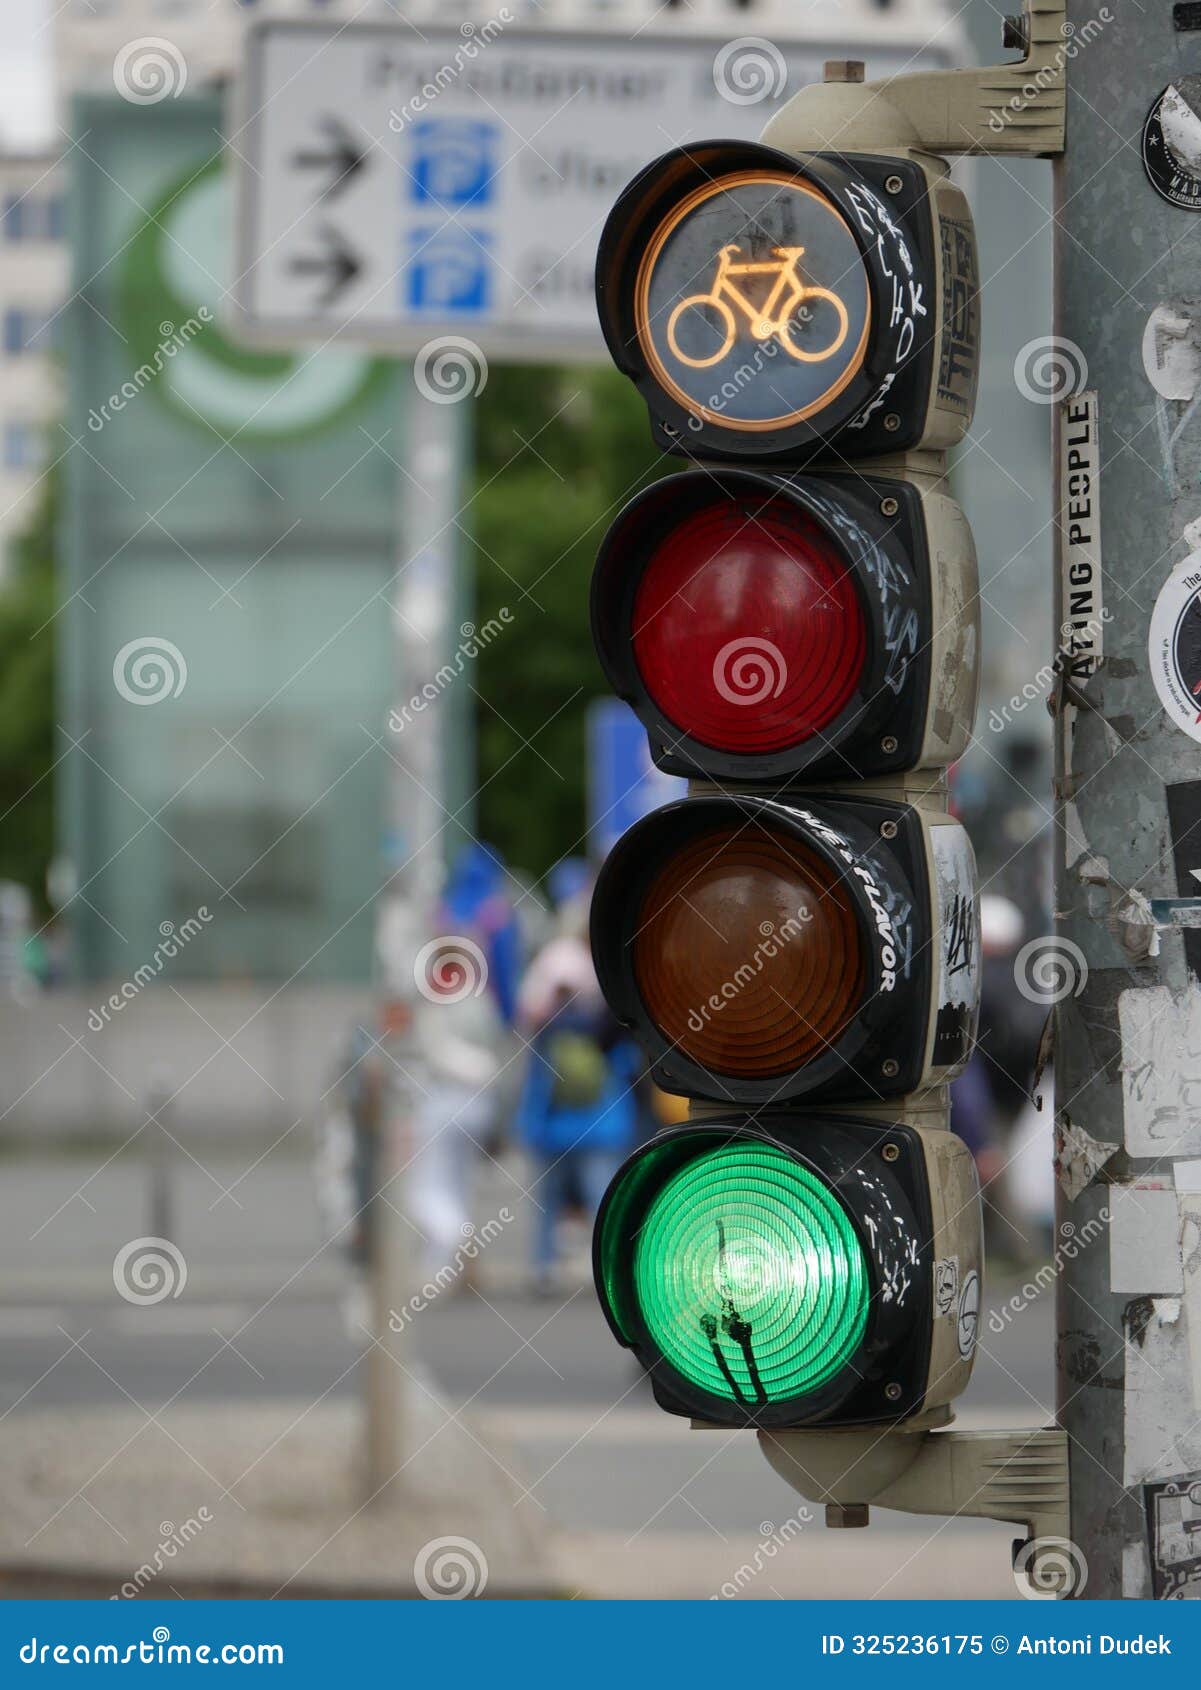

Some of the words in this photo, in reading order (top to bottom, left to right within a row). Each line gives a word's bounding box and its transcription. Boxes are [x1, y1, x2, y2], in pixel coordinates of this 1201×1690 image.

[1067, 401, 1092, 546] PEOPLE
[1181, 572, 1201, 590] The
[853, 865, 897, 993] FLAVOR
